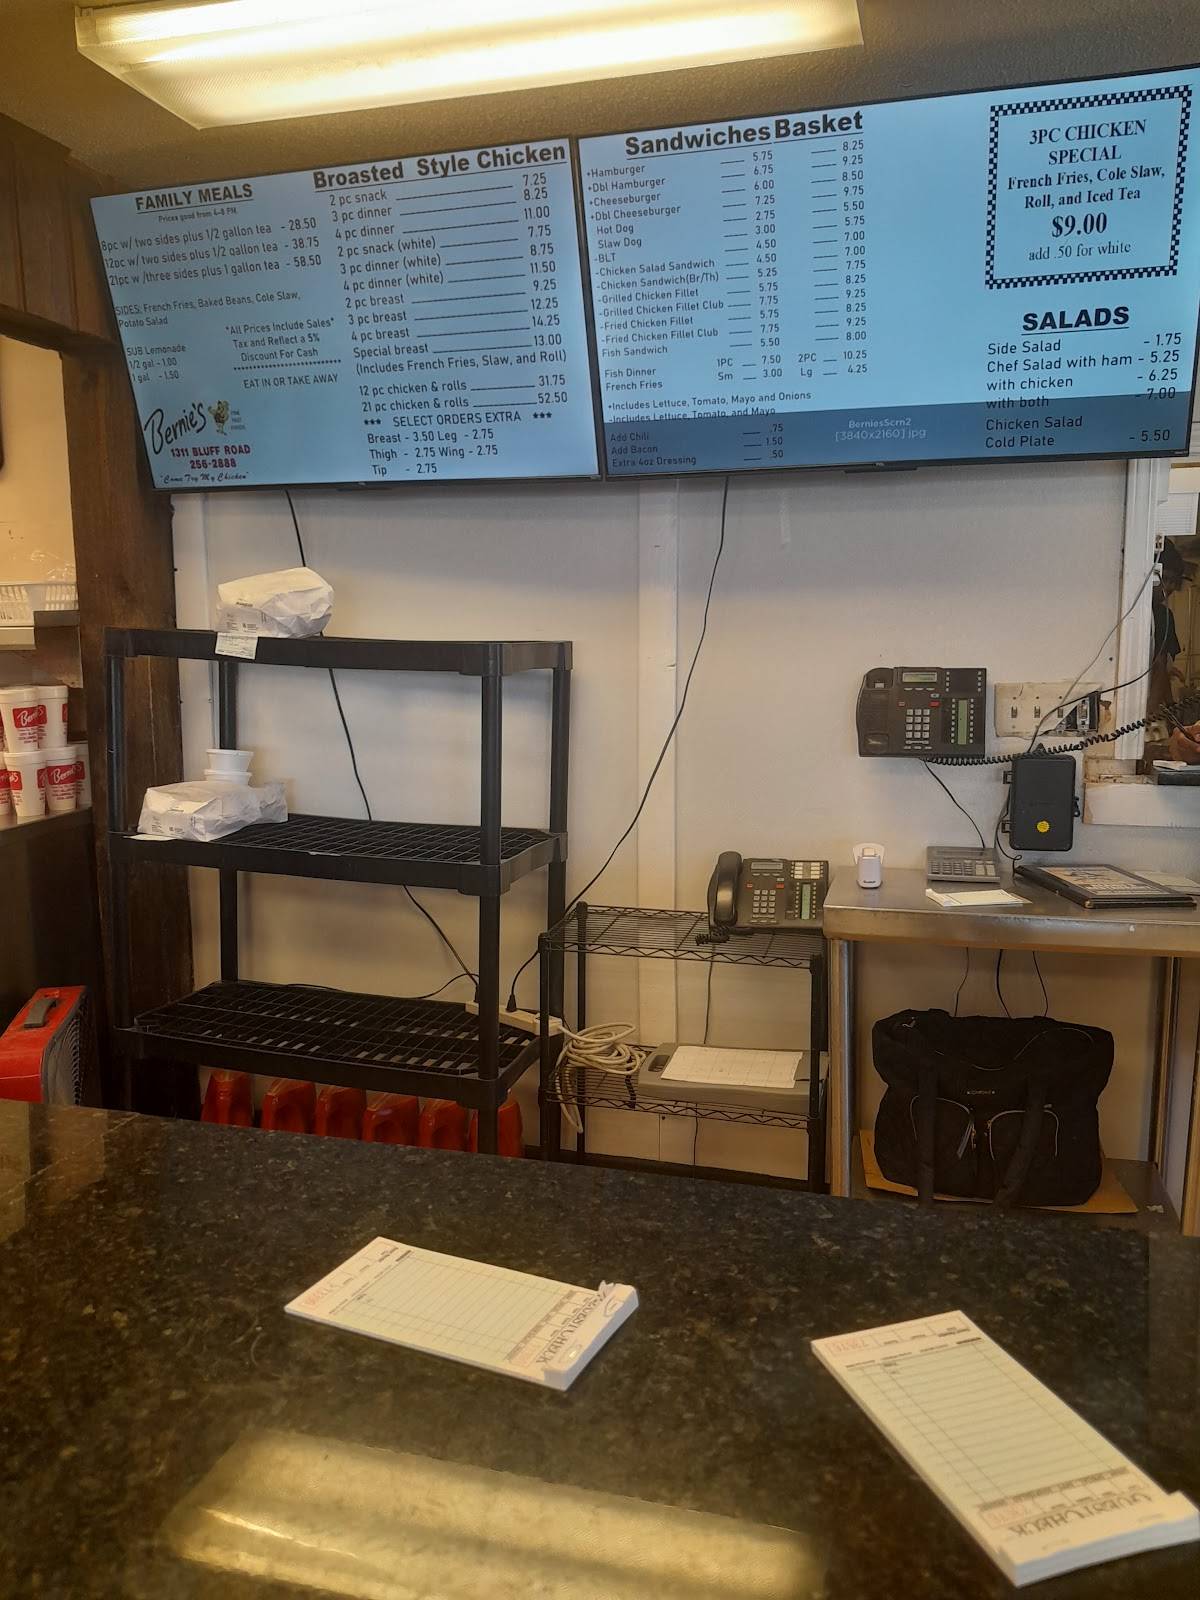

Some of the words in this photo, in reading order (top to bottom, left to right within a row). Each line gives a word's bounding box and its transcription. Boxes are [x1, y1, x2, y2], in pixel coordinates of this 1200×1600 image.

[625, 126, 771, 156] Sandwiches
[774, 111, 863, 138] Basket
[1029, 127, 1061, 145] 3PC
[1064, 120, 1146, 141] CHICKEN
[752, 149, 773, 162] 5.75
[842, 139, 864, 152] 8.25
[1048, 145, 1122, 165] SPECIAL
[312, 162, 405, 188] Broasted
[417, 155, 470, 177] Style
[476, 147, 565, 168] Chicken
[611, 177, 666, 191] Hamburger
[753, 163, 774, 176] 6.75
[842, 153, 864, 167] 9.25
[1007, 173, 1053, 190] French
[1055, 170, 1093, 186] Fries,
[1096, 167, 1127, 182] Cole
[1130, 164, 1165, 179] Slaw,
[135, 191, 197, 210] FAMILY
[198, 184, 253, 203] MEALS
[354, 188, 388, 204] snack
[522, 171, 547, 187] 7.25
[357, 206, 393, 220] dinner
[523, 186, 548, 201] 8.25
[1024, 193, 1055, 209] Roll,
[1058, 191, 1082, 206] and
[1086, 188, 1114, 203] Iced
[1118, 186, 1141, 201] Tea
[360, 224, 395, 237] dinner
[523, 205, 550, 220] 11.00
[613, 206, 681, 220] Cheeseburger
[134, 237, 153, 248] two
[154, 233, 181, 246] sides
[182, 231, 204, 245] plus
[205, 227, 221, 241] 1/2
[222, 225, 254, 241] gallon
[255, 224, 272, 234] tea
[288, 216, 317, 231] 28.50
[527, 223, 552, 238] 7.75
[596, 225, 613, 235] Hot
[615, 223, 634, 235] Dog
[1051, 213, 1108, 238] $9.00
[291, 235, 320, 250] 38.75
[597, 239, 621, 250] Slaw
[623, 236, 642, 249] Dog
[1028, 246, 1051, 261] add
[1053, 244, 1074, 260] .50
[1076, 243, 1092, 257] for
[1097, 240, 1131, 255] white
[293, 254, 322, 268] 58.50
[530, 260, 556, 274] 11.50
[639, 262, 666, 274] Salad
[668, 258, 715, 271] Sandwich
[142, 302, 172, 313] French
[197, 297, 224, 308] Baked
[255, 292, 275, 303] Cole
[530, 296, 559, 310] 12.25
[636, 304, 673, 315] Chicken
[675, 302, 700, 312] Fillet
[702, 299, 724, 310] Club
[759, 295, 779, 306] 7.75
[118, 318, 145, 328] Potato
[145, 315, 169, 327] Salad
[243, 324, 271, 334] Prices
[272, 320, 304, 331] Include
[1022, 307, 1130, 331] SALADS
[231, 339, 249, 349] Tax
[250, 337, 266, 348] and
[267, 335, 299, 346] Reflect
[307, 332, 321, 343] 5%
[353, 345, 392, 361] Special
[393, 343, 429, 356] breast
[534, 333, 562, 347] 13.00
[602, 348, 621, 358] Fish
[623, 345, 668, 357] Sandwich
[760, 336, 780, 348] 5.50
[987, 342, 1017, 356] Side
[1021, 338, 1061, 354] Salad
[1156, 332, 1182, 346] 1.75
[240, 351, 279, 362] Discount
[279, 349, 294, 359] For
[296, 347, 319, 358] Cash
[356, 361, 405, 377] (Includes
[406, 357, 445, 371] French
[447, 356, 479, 369] Fries,
[481, 354, 513, 367] Slaw,
[515, 351, 537, 364] and
[539, 348, 567, 363] Roll)
[604, 368, 624, 378] Fish
[626, 367, 657, 377] Dinner
[761, 354, 782, 365] 7.50
[843, 349, 868, 360] 10.25
[987, 359, 1019, 373] Chef
[1023, 357, 1062, 371] Salad
[1066, 355, 1096, 369] with
[1101, 354, 1132, 367] ham
[1150, 349, 1180, 364] 5.25
[243, 378, 259, 389] EAT
[261, 377, 272, 387] IN
[272, 376, 287, 387] OR
[287, 375, 311, 385] TAKE
[313, 373, 338, 384] AWAY
[387, 383, 428, 395] chicken
[441, 379, 468, 392] rolls
[538, 373, 566, 387] 31.75
[605, 381, 638, 391] French
[639, 379, 663, 390] Fries
[986, 378, 1015, 392] with
[1020, 375, 1073, 390] chicken
[1148, 367, 1178, 382] 6.25
[537, 391, 568, 404] 52.50
[652, 399, 690, 409] Lettuce,
[691, 396, 729, 406] Tomato,
[731, 394, 756, 406] Mayo
[758, 392, 776, 402] and
[778, 391, 812, 401] Onions
[985, 396, 1015, 409] with
[1019, 395, 1049, 408] both
[392, 414, 433, 428] SELECT
[436, 412, 483, 426] ORDERS
[485, 410, 522, 423] EXTRA
[986, 418, 1040, 431] Chicken
[1044, 415, 1083, 429] Salad
[144, 403, 207, 455] Bernie's
[367, 433, 402, 444] Breast
[412, 430, 435, 442] 3.50
[437, 430, 458, 444] Leg
[472, 428, 494, 440] 2.75
[610, 432, 628, 443] Add
[629, 431, 649, 442] Chili
[985, 436, 1015, 449] Cold
[1020, 435, 1055, 448] Plate
[1141, 428, 1171, 442] 5.50
[170, 447, 190, 458] 1311
[191, 445, 220, 457] BLUFF
[223, 444, 251, 455] ROAD
[368, 448, 398, 462] Thigh
[414, 446, 436, 458] 2.75
[438, 446, 465, 460] Wing
[476, 444, 498, 456] 2.75
[611, 445, 629, 455] Add
[630, 444, 659, 454] Bacon
[189, 457, 237, 470] 256-2888
[371, 464, 388, 477] Tip
[416, 462, 438, 474] 2.75
[612, 458, 637, 468] Extra
[656, 456, 697, 466] Dressing
